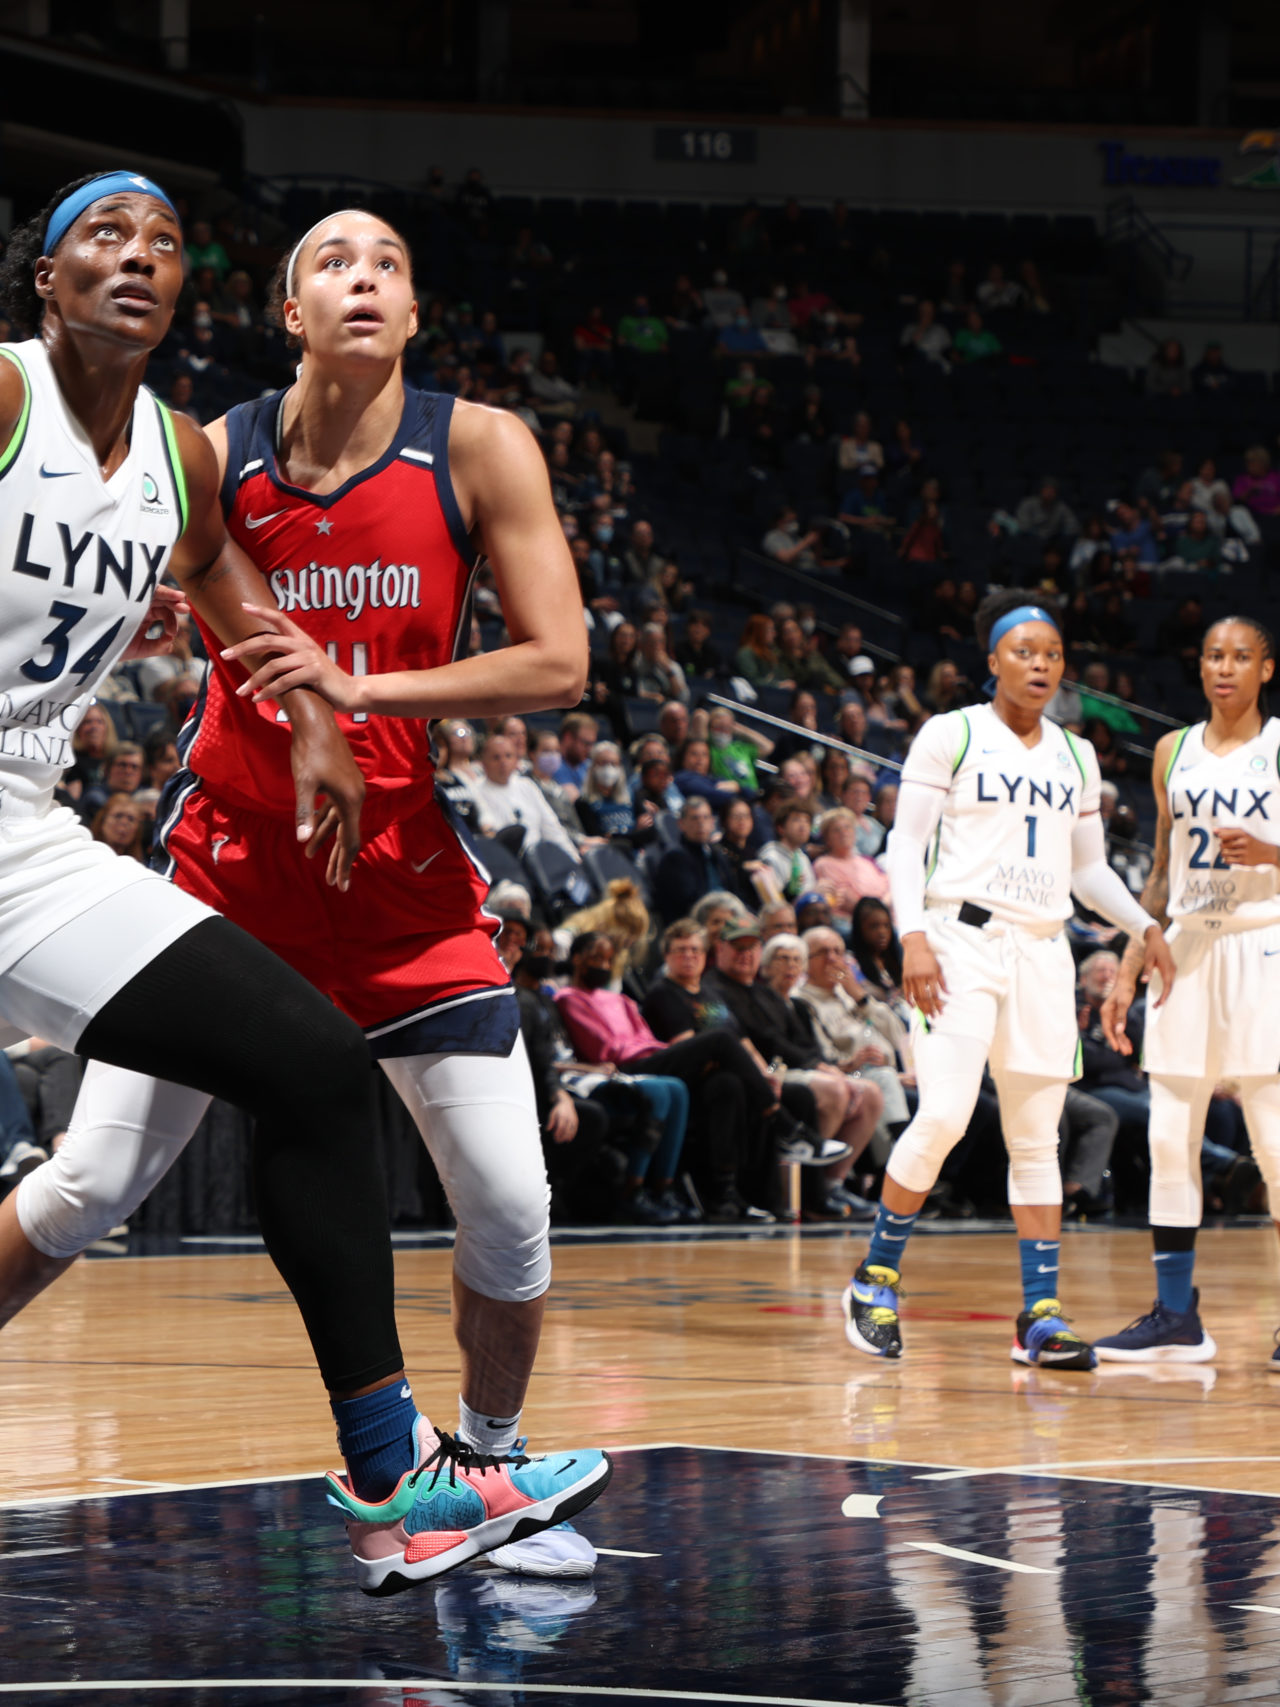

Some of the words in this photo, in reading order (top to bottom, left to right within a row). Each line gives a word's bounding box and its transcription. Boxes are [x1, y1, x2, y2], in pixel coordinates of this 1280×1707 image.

[681, 130, 733, 160] 116
[12, 511, 168, 603] LYNX
[270, 557, 421, 621] shington
[20, 600, 127, 687] 34
[977, 772, 1075, 816] LYNX
[1172, 787, 1272, 820] LYNX
[1024, 814, 1038, 859] 1
[986, 880, 1055, 908] CLINIC
[995, 864, 1056, 889] MAYO
[1184, 879, 1237, 897] MAYO
